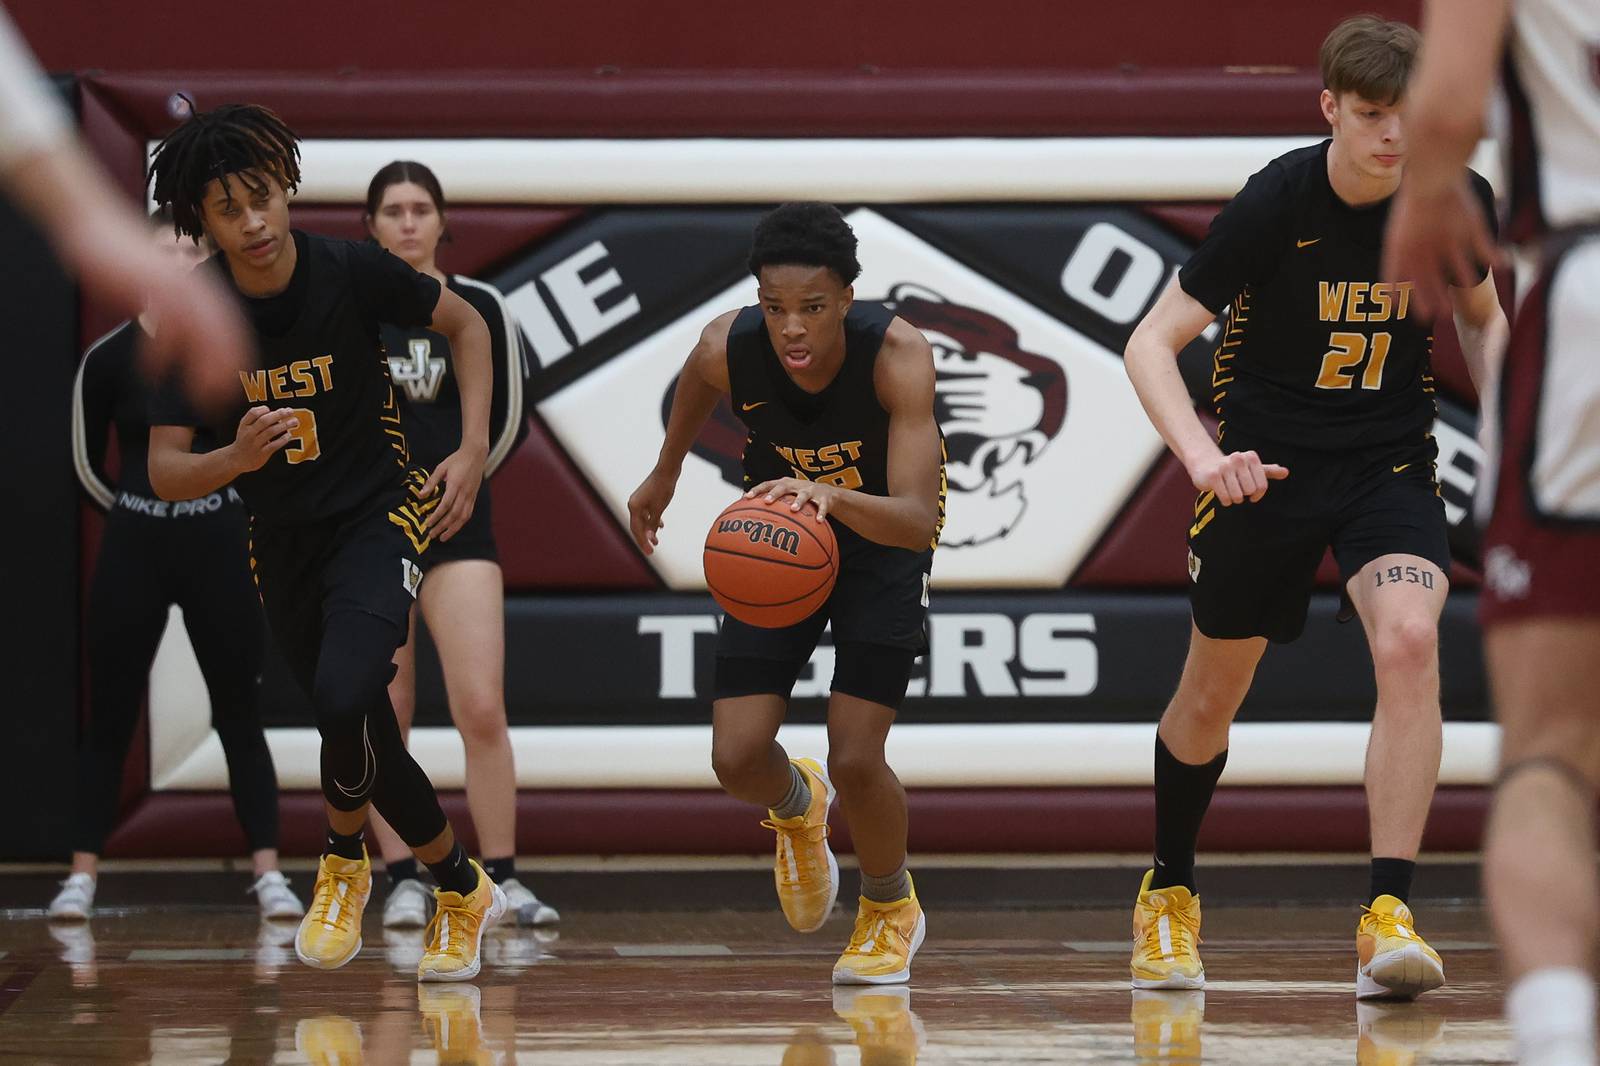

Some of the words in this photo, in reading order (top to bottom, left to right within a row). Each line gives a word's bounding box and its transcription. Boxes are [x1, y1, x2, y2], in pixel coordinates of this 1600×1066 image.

[1318, 281, 1416, 322] WEST
[239, 354, 334, 402] WEST
[1315, 331, 1393, 390] 21
[119, 491, 169, 518] NIKE
[172, 493, 223, 518] PRO
[717, 518, 800, 557] Wilson
[1375, 565, 1434, 590] 1950
[637, 613, 1099, 698] TRS
